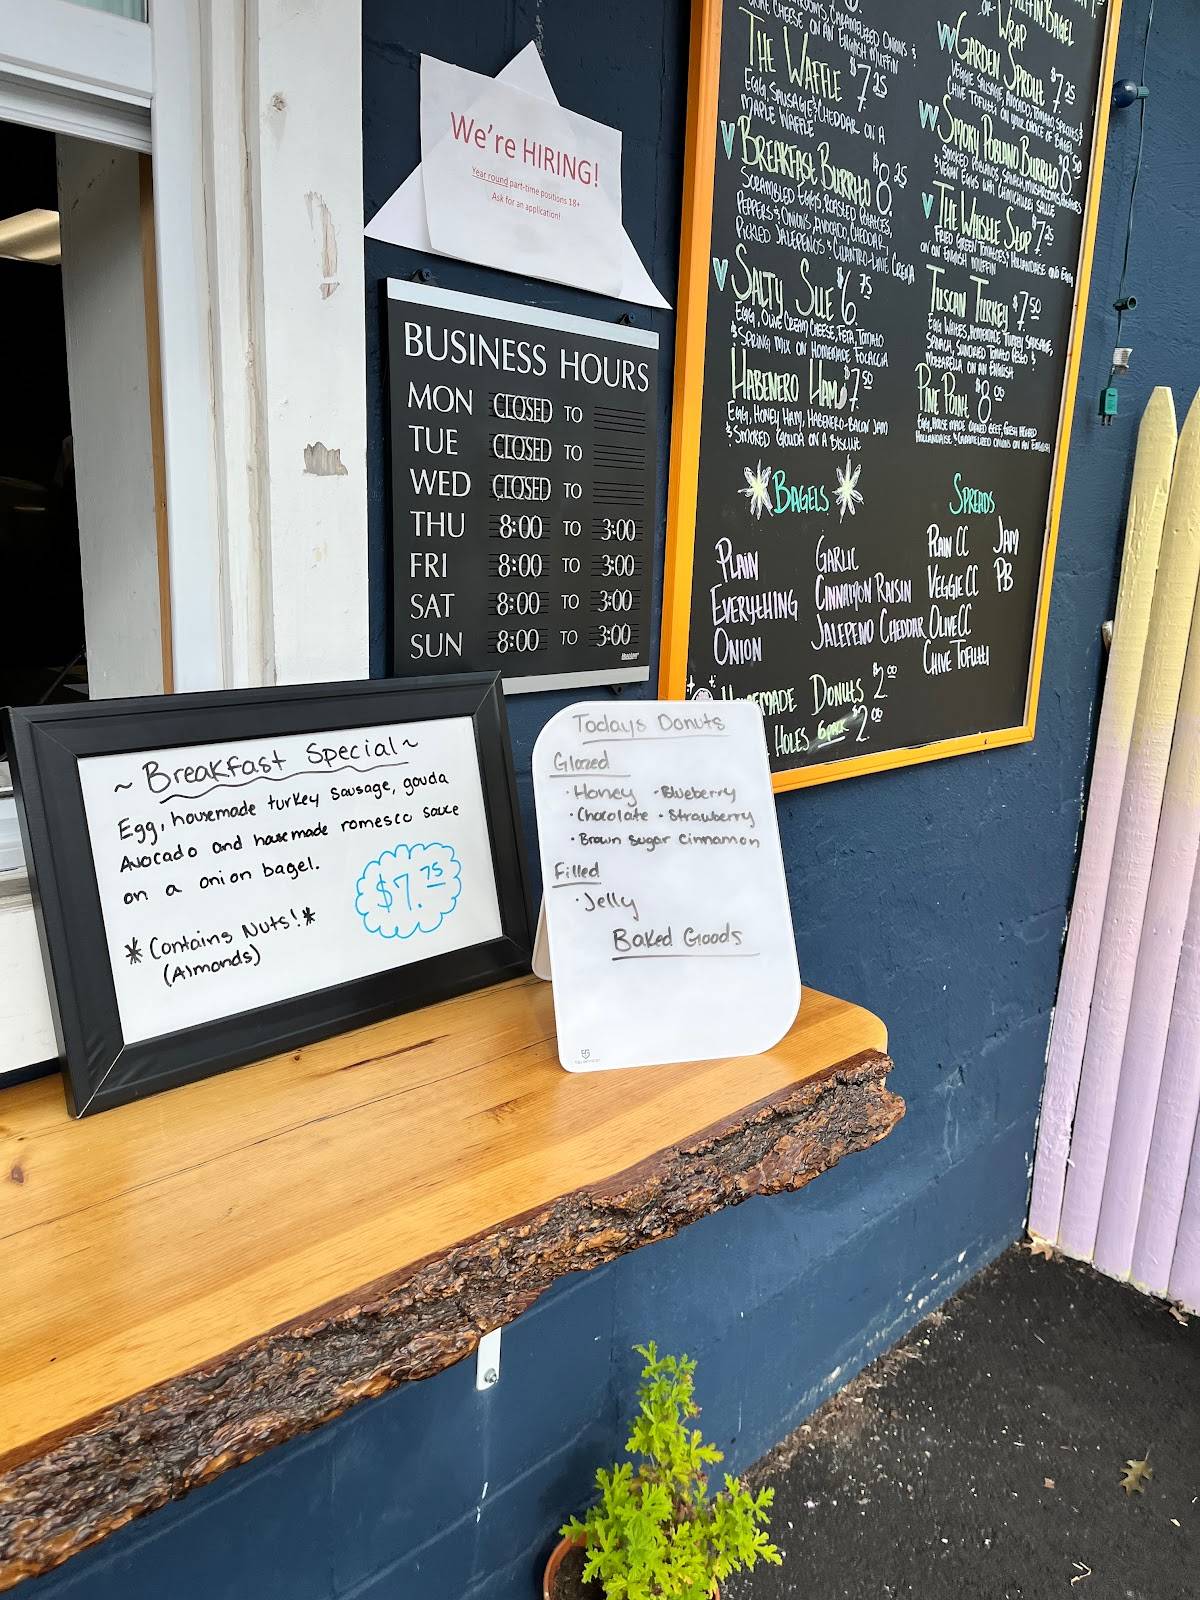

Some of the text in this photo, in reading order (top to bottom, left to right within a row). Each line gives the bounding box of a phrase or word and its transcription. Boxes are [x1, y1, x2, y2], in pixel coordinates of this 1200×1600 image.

[810, 19, 821, 35] ON
[822, 24, 834, 42] AN
[739, 6, 776, 73] THE
[783, 25, 843, 103] WAFFLE
[955, 11, 1000, 80] GARDEN
[1003, 41, 1045, 106] SPROUT
[779, 106, 815, 138] WAFFLE
[864, 123, 875, 140] ON
[878, 126, 886, 145] A
[937, 94, 980, 160] SMOKY
[981, 114, 1019, 169] POBLANO
[523, 138, 600, 187] HIRING!
[737, 115, 818, 185] BREAKFAST
[817, 142, 871, 206] BURRITO
[472, 166, 580, 208] Year round part-time positions 18+
[741, 166, 795, 205] SCRAMBLED
[491, 192, 561, 220] Ask for an application!
[933, 180, 958, 231] THE
[961, 191, 1001, 245] WHISTLE
[1004, 206, 1032, 254] STOP
[736, 216, 771, 243] PICKLED
[731, 243, 783, 318] SALTY
[796, 258, 834, 321] SUE
[926, 264, 966, 317] TUSCAN
[970, 275, 1009, 333] TURKEY
[404, 322, 649, 392] BUSINESS HOURS
[796, 340, 807, 356] ON
[731, 347, 799, 402] HABENERO
[809, 358, 838, 409] HAM
[915, 363, 940, 415] PINE
[941, 372, 969, 418] POINT
[407, 381, 583, 423] MON CLOSED TO
[408, 425, 582, 463] TUE CLOSED TO
[734, 426, 770, 448] SMOKED
[809, 434, 820, 447] ON
[821, 436, 827, 448] A
[410, 468, 582, 502] WED CLOSED TO
[772, 470, 829, 514] BAGELS
[950, 472, 995, 514] SPREADS
[410, 510, 636, 542] THU 8:00 TO 3:00
[927, 524, 970, 558] PLAIN CC
[993, 515, 1020, 555] JAM
[410, 553, 635, 577] FRI 8:00 TO 3:00
[715, 537, 758, 583] PLAIN
[815, 534, 859, 573] GARLIC
[815, 572, 912, 612] CINNAMON RAISIN
[928, 564, 979, 600] VEGGIE CC
[994, 557, 1013, 592] PB
[410, 589, 632, 619] SAT 8:00 TO 3:00
[710, 583, 798, 626] EVERYTHING
[929, 604, 972, 640] OLIVE CC
[410, 623, 631, 659] SUN 8:00 TO 3:00
[714, 627, 762, 666] ONION
[811, 608, 927, 650] JALEPENO CHEDDAR
[923, 638, 989, 676] CHIVE TOFUTTI
[809, 673, 864, 716] DONUTS
[572, 713, 725, 738] Todays Donuts
[775, 725, 810, 757] HOLES
[142, 736, 397, 794] Breakfast Special
[553, 750, 610, 771] Glazed
[118, 769, 448, 845] Egg, housemade turkey sausage, gouda
[574, 784, 736, 807] Honey Blueberry
[578, 807, 755, 828] Chocolate Strawberry
[119, 845, 197, 872] Avocado
[212, 836, 242, 854] and
[341, 813, 412, 831] romesco
[423, 803, 459, 818] sauce
[579, 834, 621, 845] Brown
[124, 856, 320, 906] on a onion bagel.
[554, 861, 599, 880] Filled
[584, 892, 639, 921] Jelly
[613, 923, 742, 952] Baked Goods
[163, 945, 261, 987] (Almonds)
